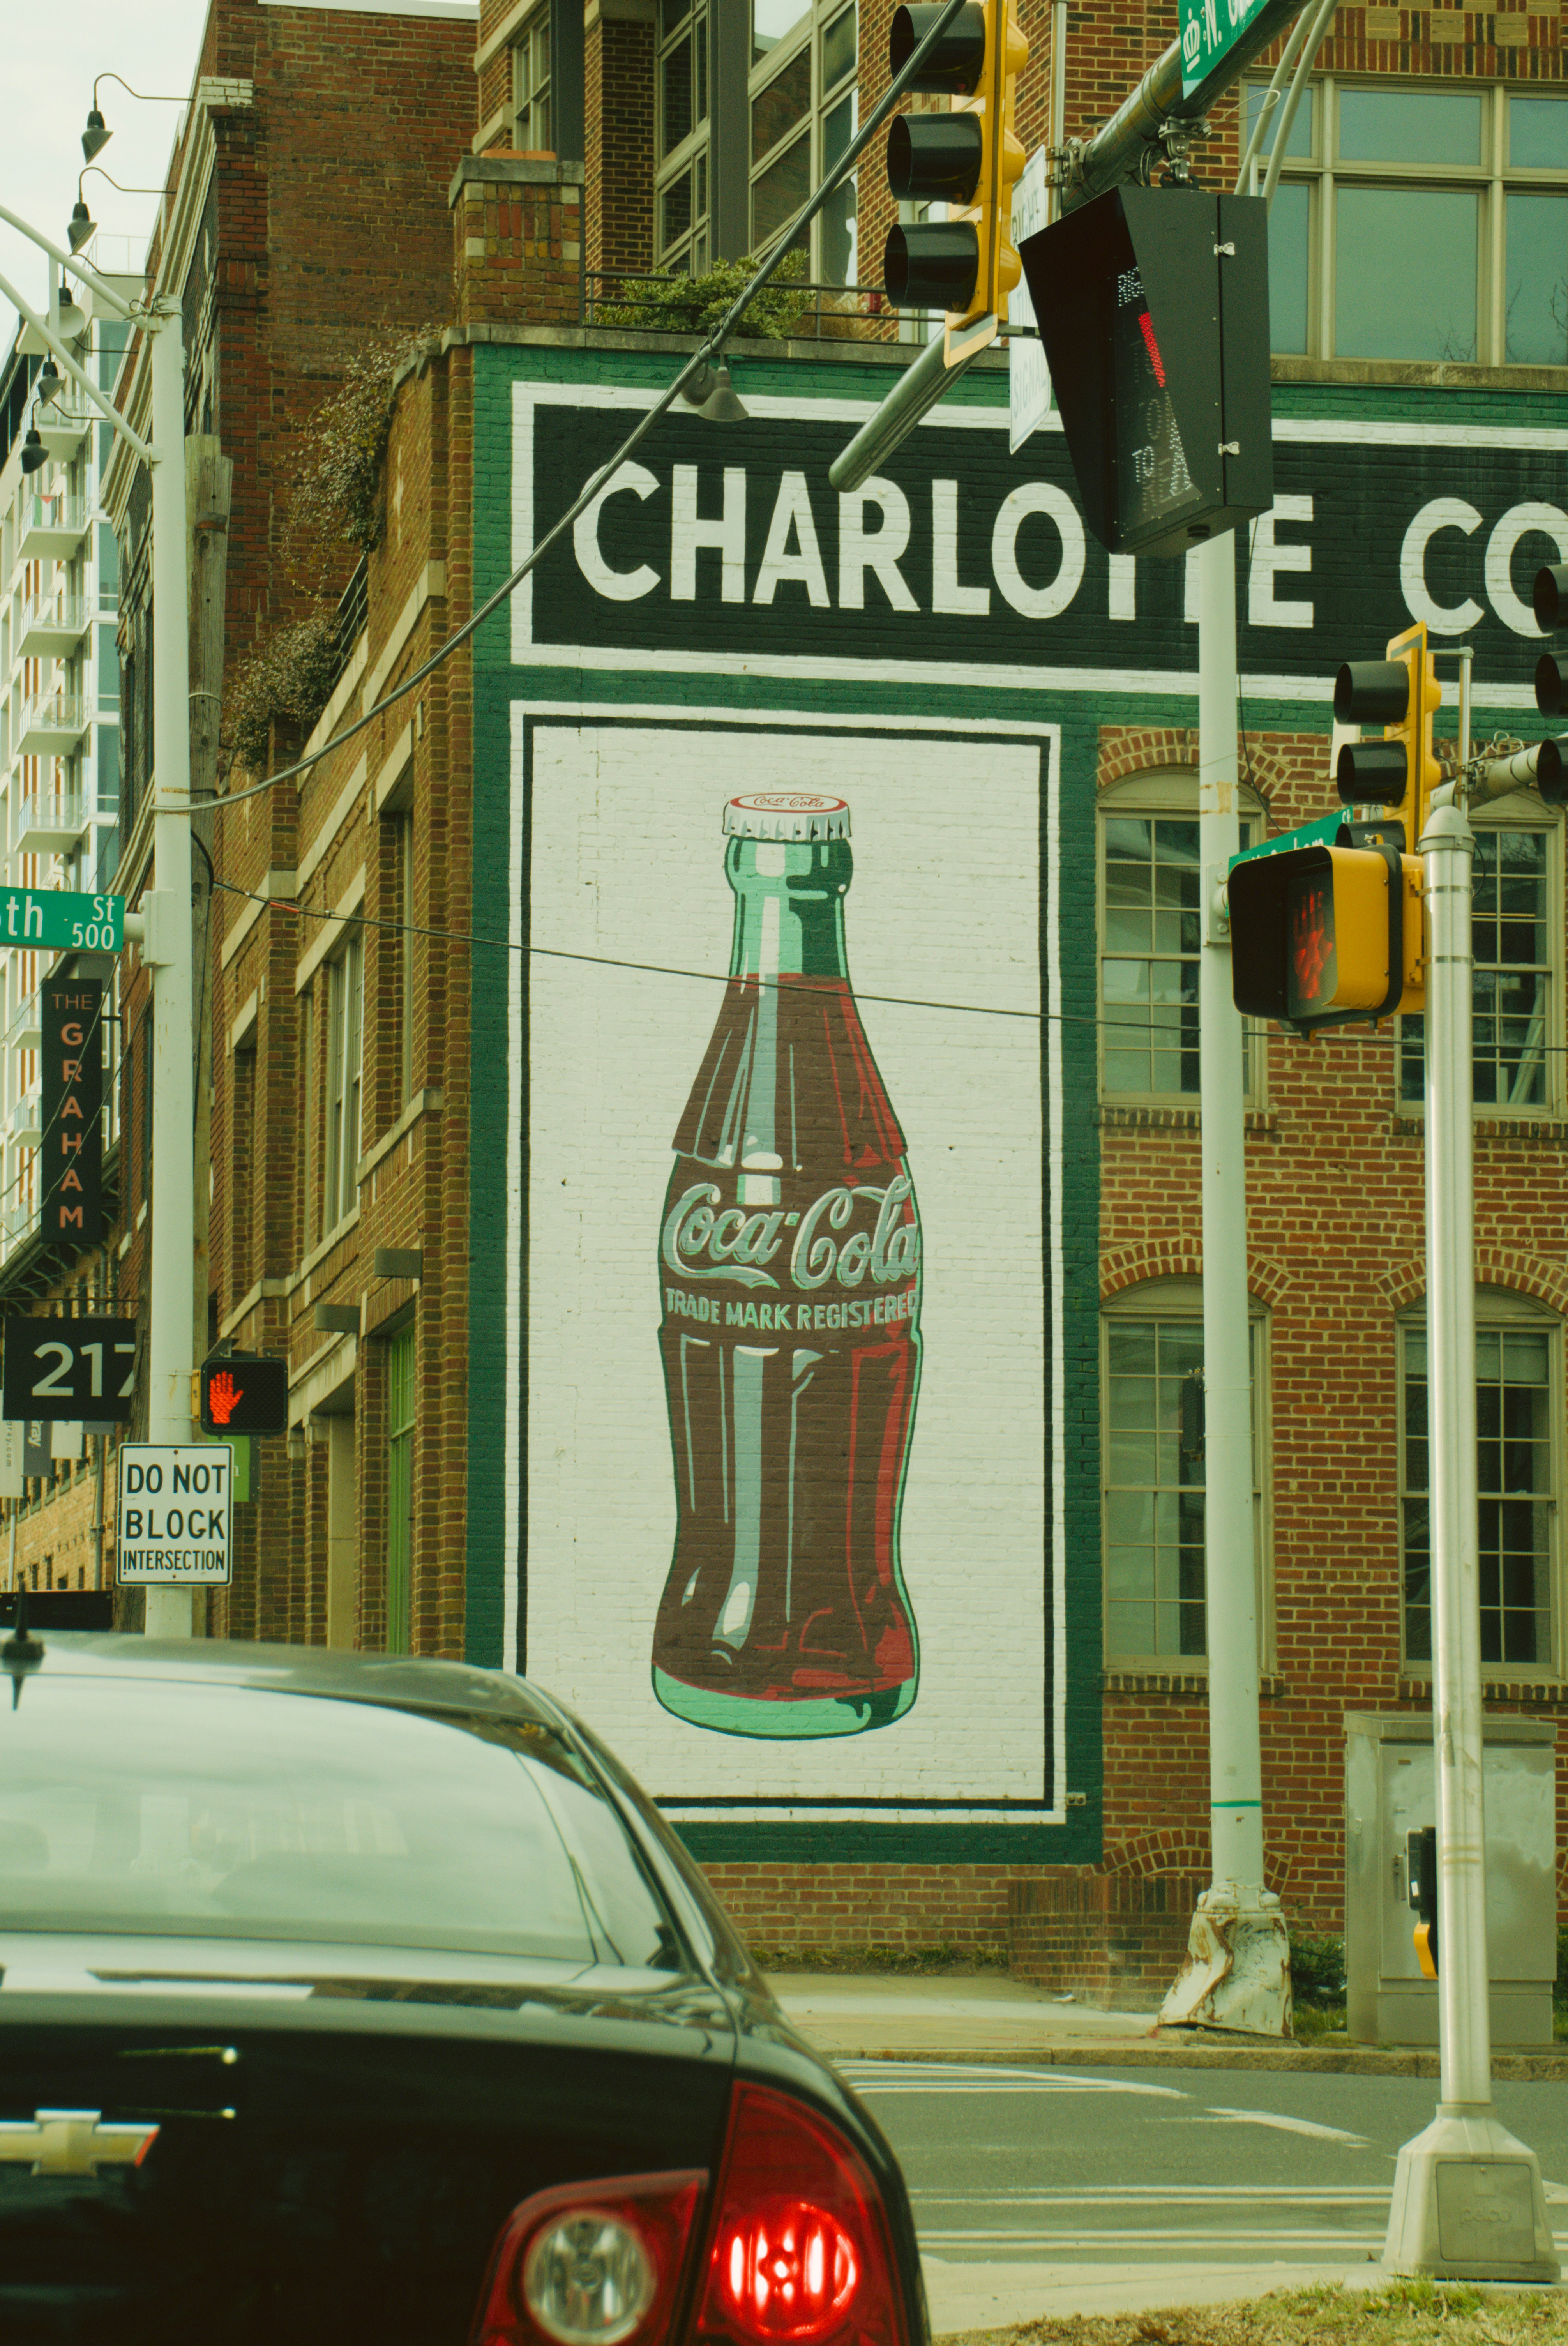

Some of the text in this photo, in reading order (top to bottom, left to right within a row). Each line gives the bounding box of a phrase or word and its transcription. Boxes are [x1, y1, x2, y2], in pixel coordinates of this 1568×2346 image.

[1014, 347, 1046, 419] SIGNAL
[574, 459, 1314, 628] CHARLOE
[754, 796, 825, 807] Coca-Cola
[0, 896, 115, 938] th St
[72, 922, 115, 950] 500
[51, 994, 93, 1010] THE
[59, 1023, 84, 1228] GRAHAM
[663, 1175, 919, 1290] Coca-Cola
[665, 1288, 918, 1330] TRADE MARK REGISTERED
[127, 1464, 163, 1494] DO
[173, 1464, 226, 1494] NOT
[126, 1509, 225, 1539] BLOCK
[123, 1550, 225, 1570] INTERSECTION
